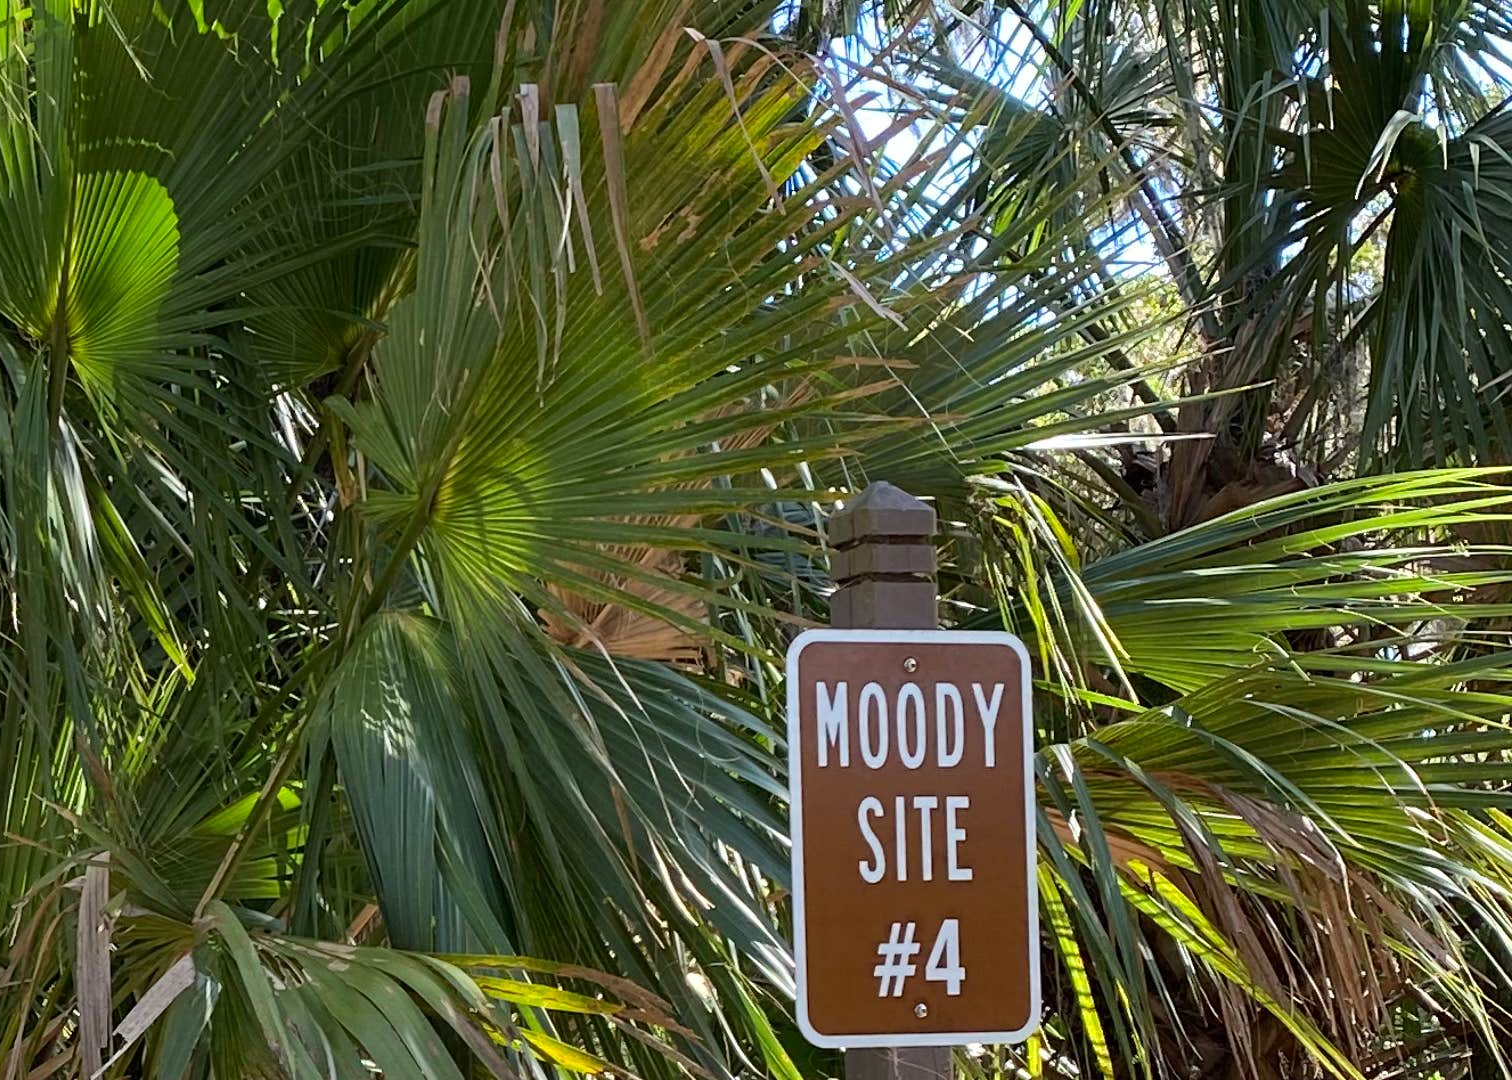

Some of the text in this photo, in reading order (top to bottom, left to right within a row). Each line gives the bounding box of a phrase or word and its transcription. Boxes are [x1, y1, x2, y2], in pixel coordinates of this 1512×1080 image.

[815, 681, 1005, 770] MOODY
[857, 796, 973, 884] SITE
[873, 918, 966, 997] #4
